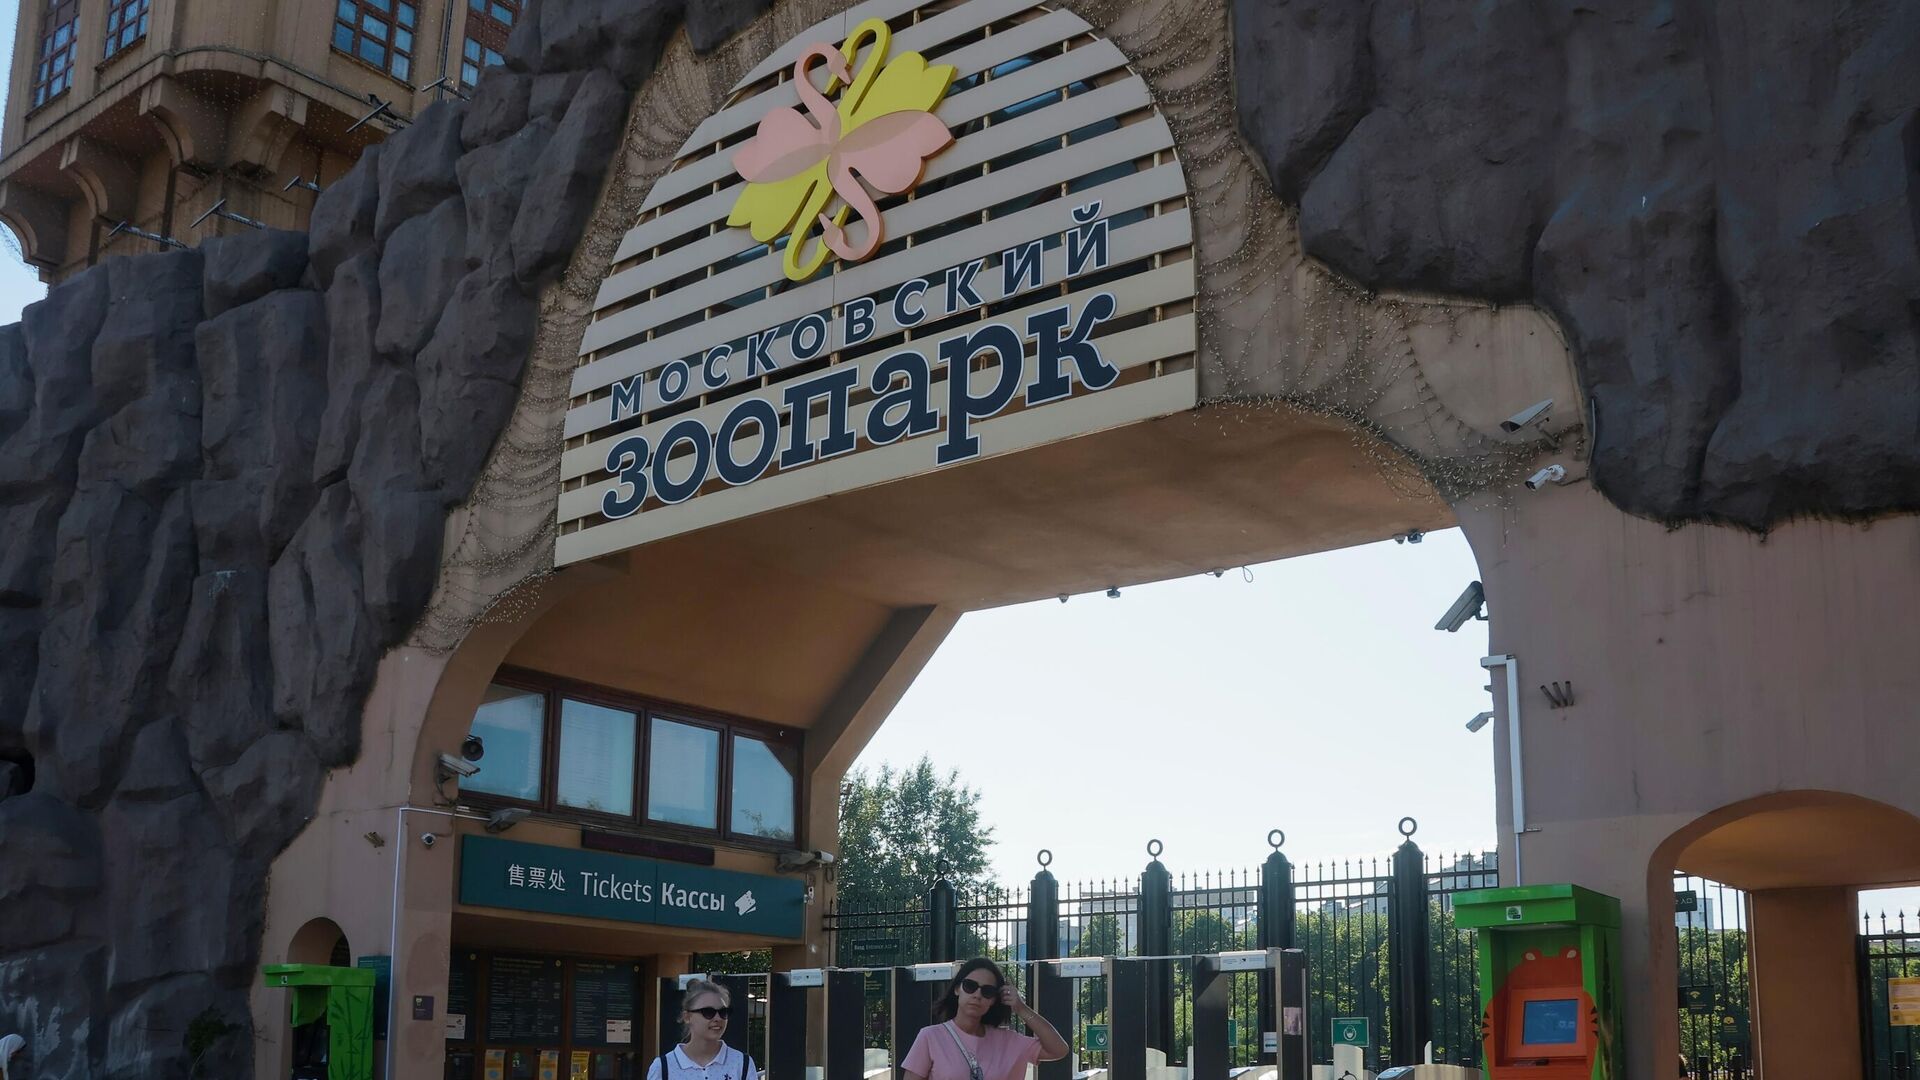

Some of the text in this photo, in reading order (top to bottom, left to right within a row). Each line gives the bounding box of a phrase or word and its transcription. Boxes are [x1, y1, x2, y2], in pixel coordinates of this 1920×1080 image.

[507, 863, 726, 912] 售票处 Tickets Кассы
